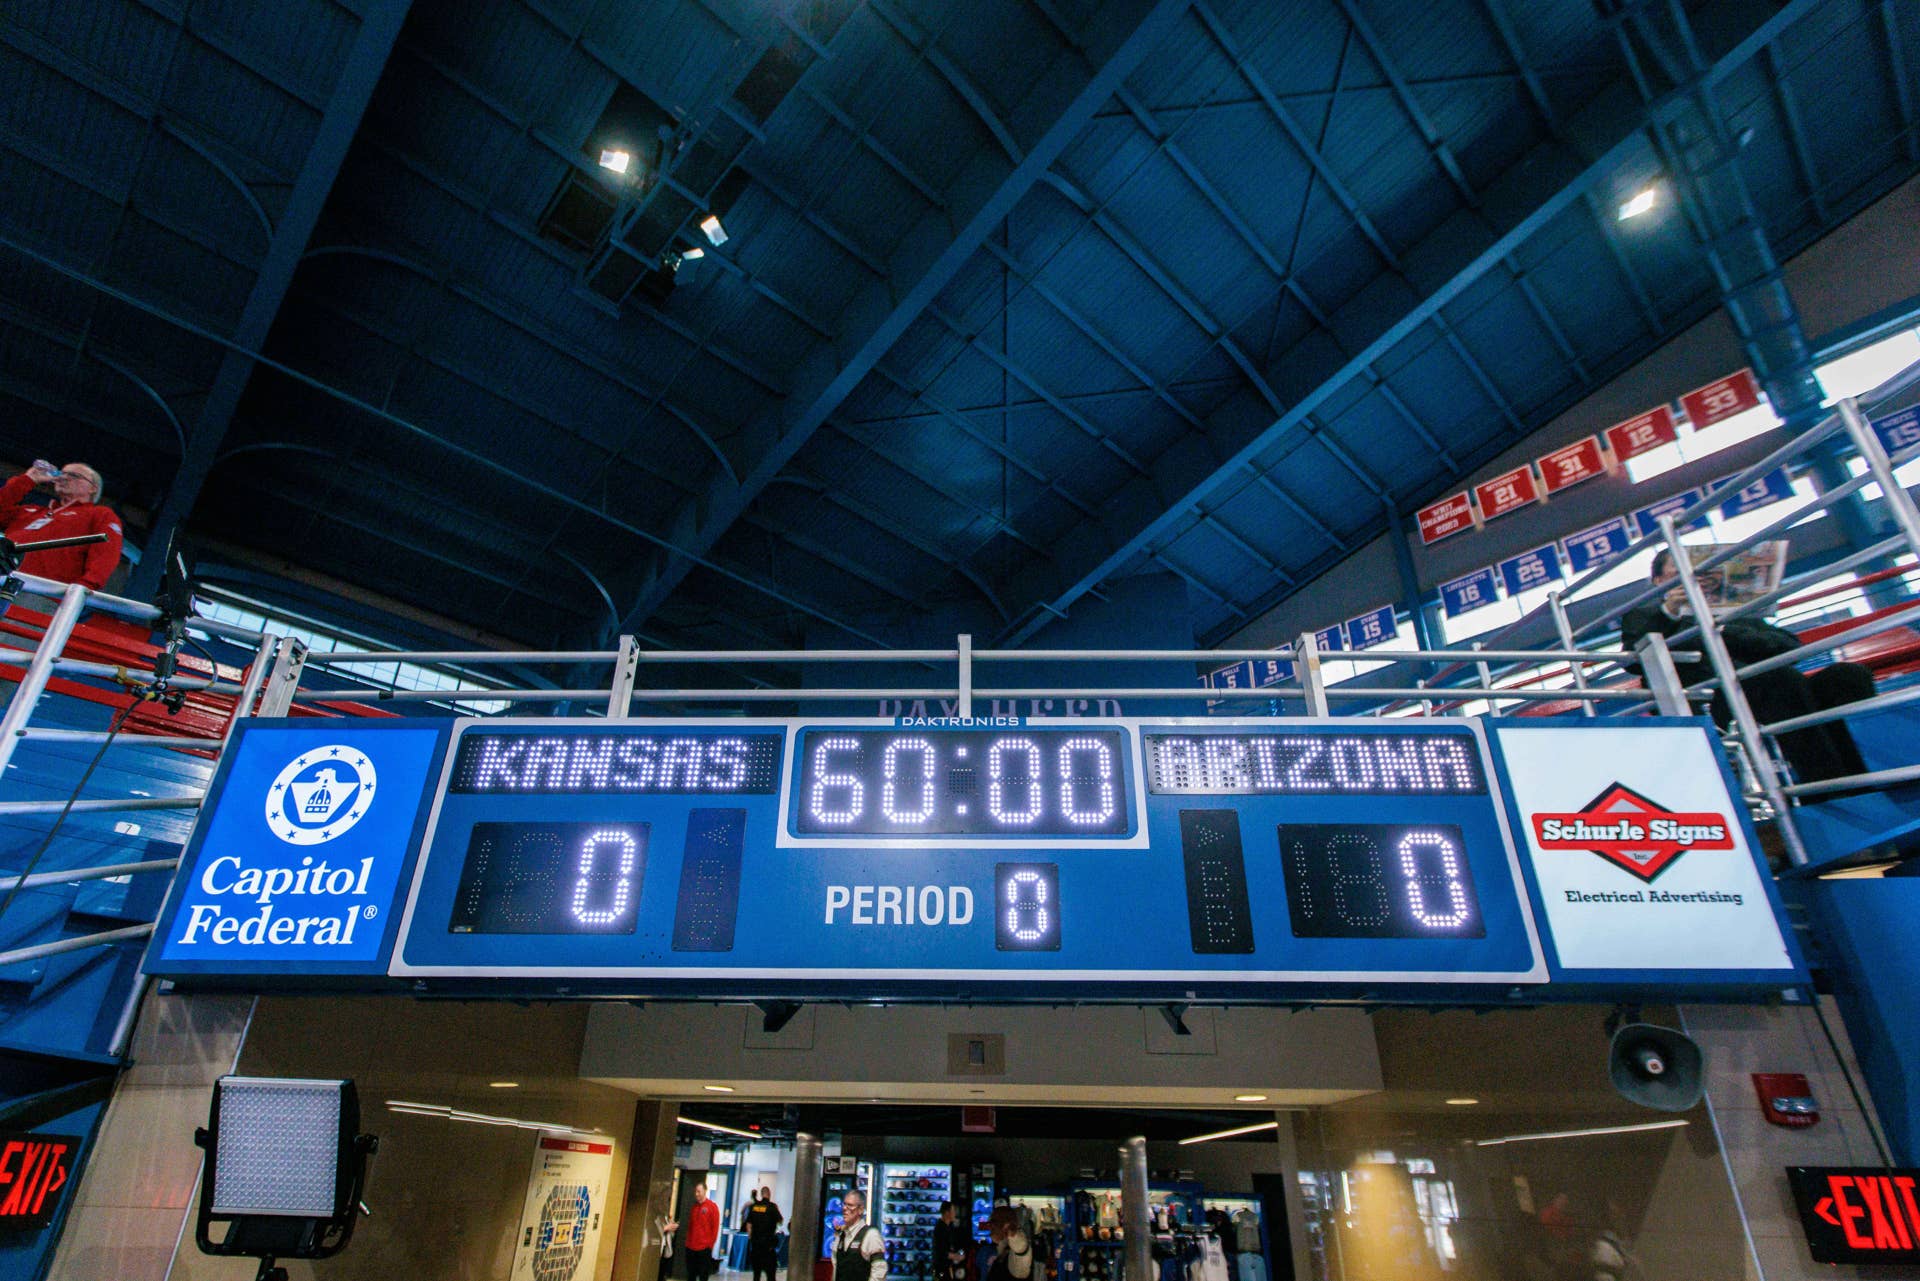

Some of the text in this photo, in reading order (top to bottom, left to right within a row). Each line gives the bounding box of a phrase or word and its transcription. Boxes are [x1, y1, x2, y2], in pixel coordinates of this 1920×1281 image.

[1702, 386, 1738, 416] 33
[1628, 423, 1656, 447] 12
[1556, 453, 1584, 478] 31
[1493, 483, 1517, 505] 21
[1583, 534, 1611, 560] 13
[1516, 558, 1546, 584] 25
[1457, 583, 1480, 605] 16
[1362, 620, 1382, 640] 15
[1267, 661, 1278, 675] 5
[1227, 675, 1237, 688] 5
[902, 717, 1019, 727] DAKTRONICS
[477, 739, 748, 788] KANSAS
[1159, 739, 1472, 788] ARIZONA
[811, 738, 1113, 824] 60:00
[1542, 819, 1725, 845] Schurle Signs
[1633, 852, 1651, 861] Inc.
[201, 856, 375, 904] Capitol
[571, 830, 636, 924] 0
[1398, 832, 1469, 927] 0
[824, 871, 1048, 940] PERIOD 0
[1564, 890, 1744, 906] Electrical Advertising
[0, 1141, 67, 1215] EXIT
[1827, 1175, 1920, 1250] EXIT
